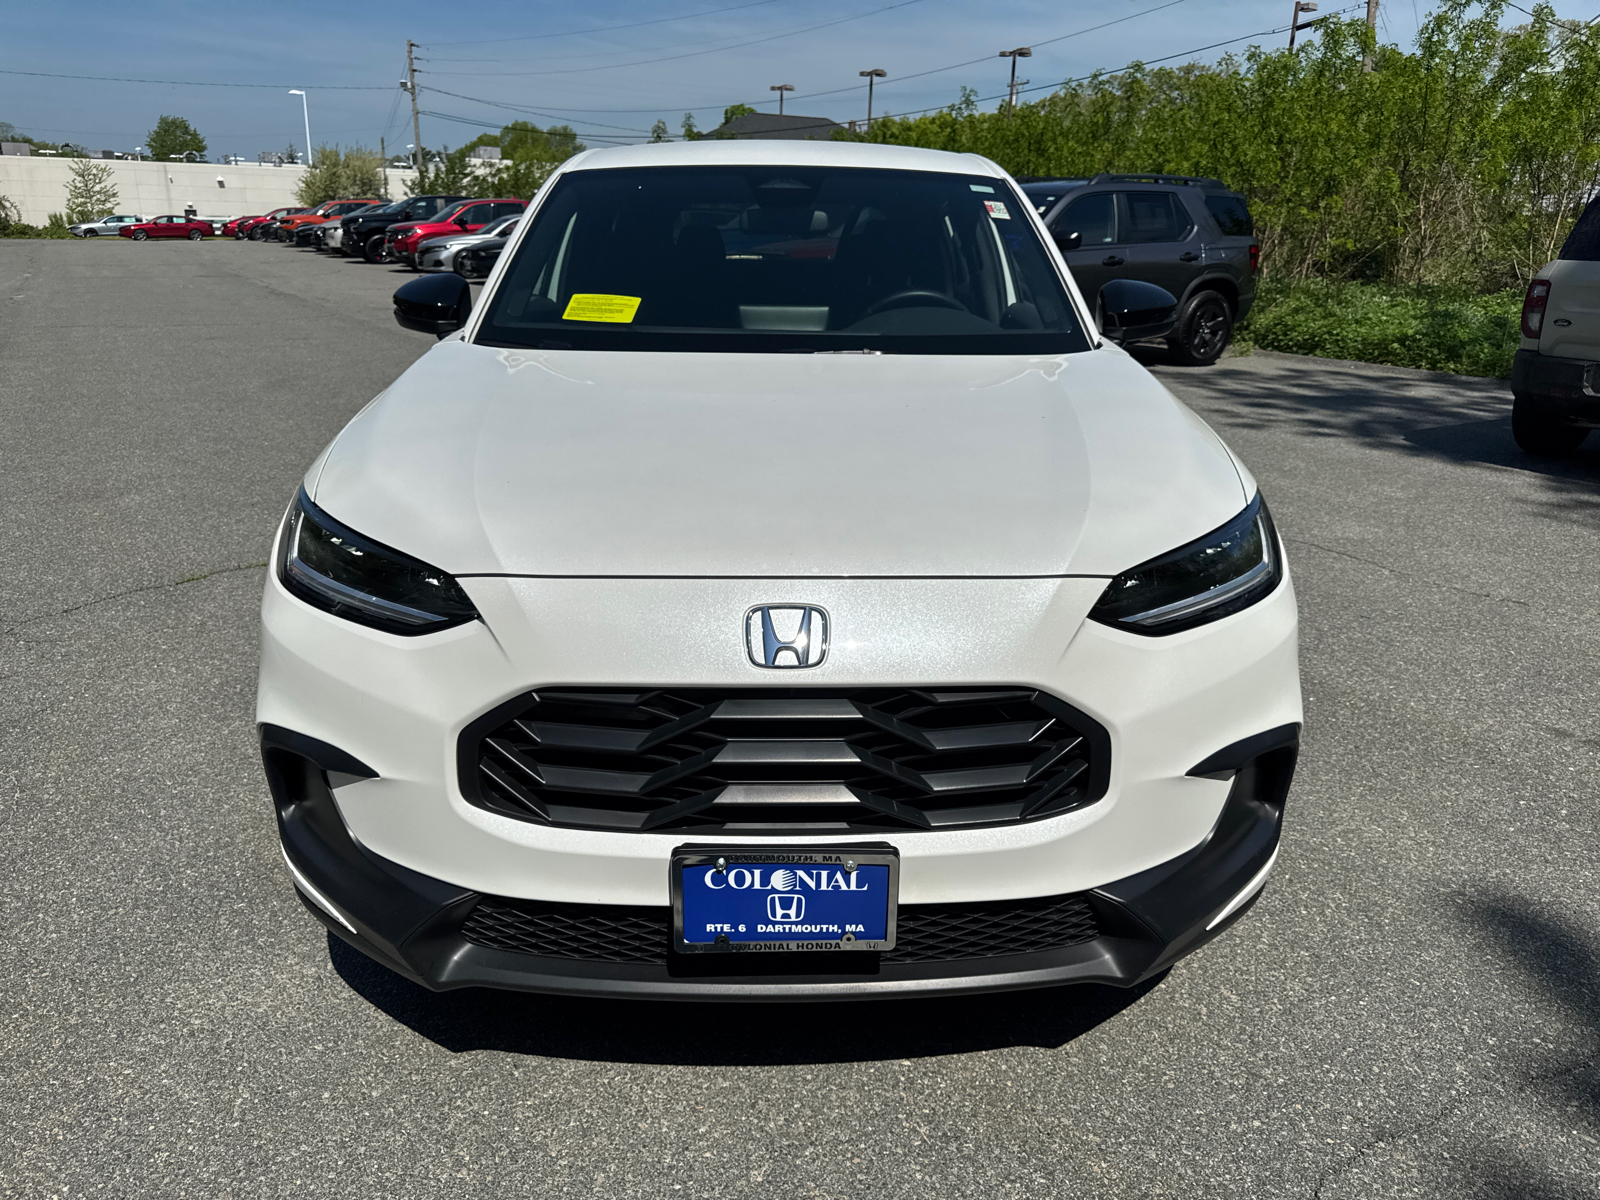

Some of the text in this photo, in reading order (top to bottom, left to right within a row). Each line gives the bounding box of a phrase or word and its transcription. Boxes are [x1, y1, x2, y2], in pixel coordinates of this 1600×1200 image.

[822, 855, 842, 863] MA
[704, 868, 868, 891] COLONIAL
[706, 923, 865, 933] RTE. 6 DARTMOUTH, MA
[730, 942, 842, 952] COLONIAL HONDA
